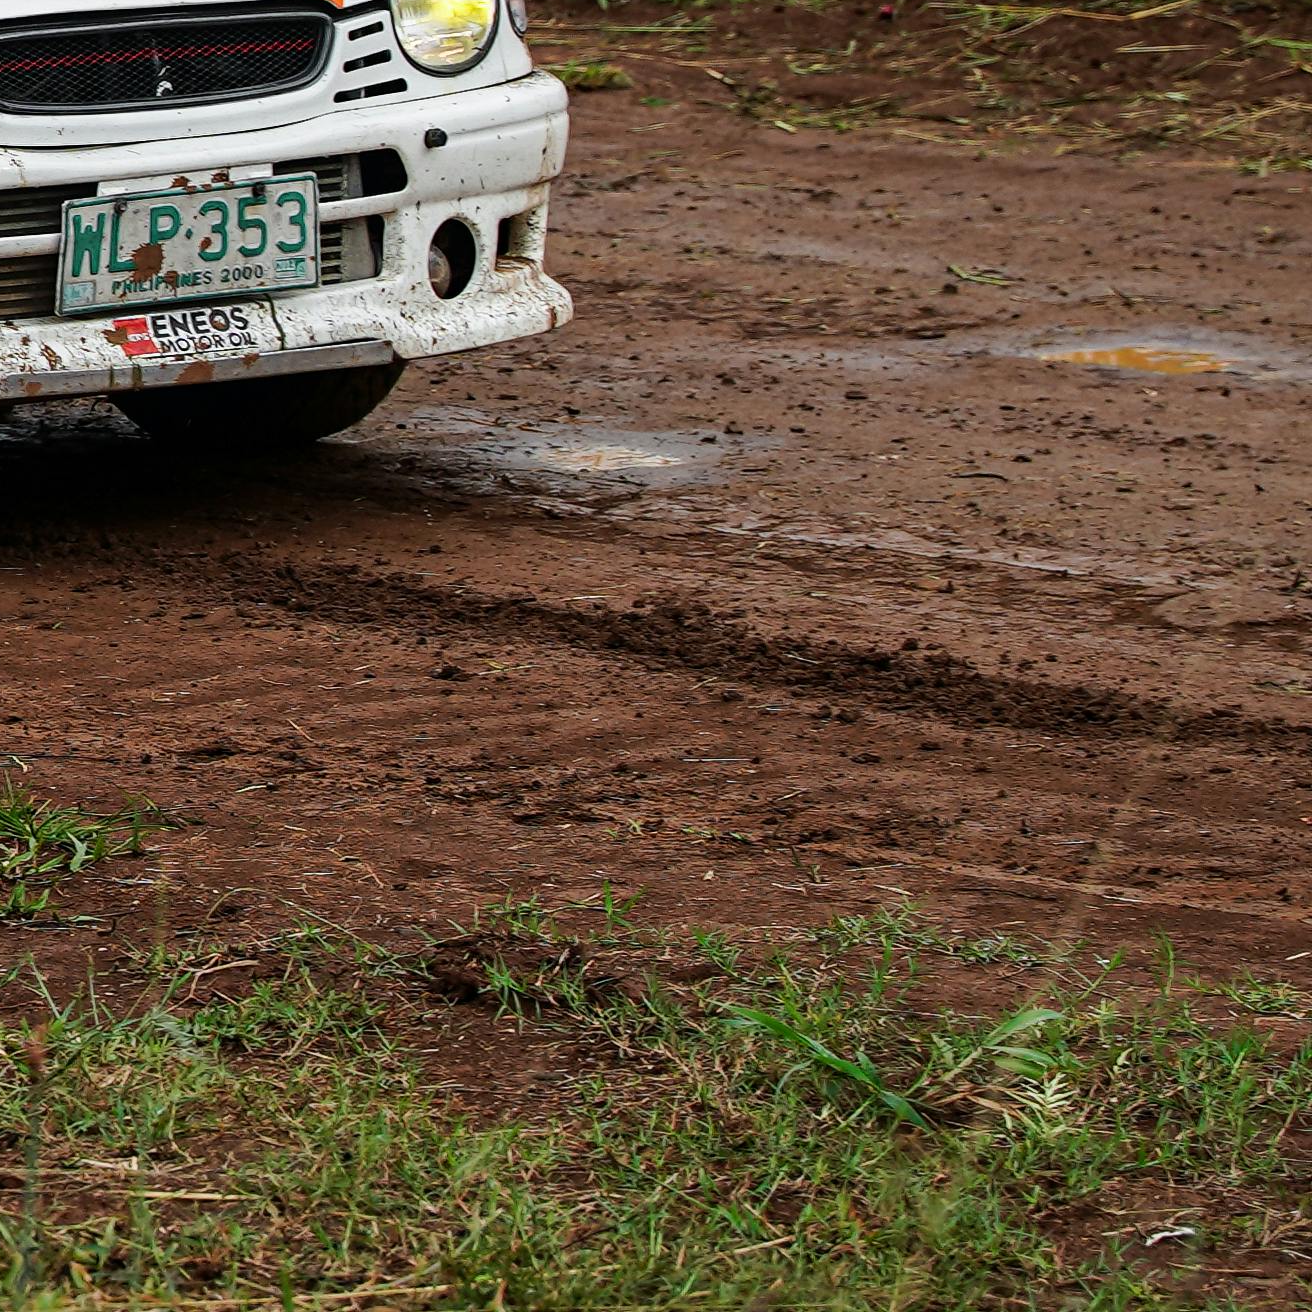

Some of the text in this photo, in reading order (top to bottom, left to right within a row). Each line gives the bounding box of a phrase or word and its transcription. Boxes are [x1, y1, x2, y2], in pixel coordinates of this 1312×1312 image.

[111, 270, 213, 295] PHILIPINES
[220, 263, 265, 284] 2000
[150, 306, 250, 339] ENEOS
[159, 332, 226, 354] MOTOR
[228, 330, 257, 348] OIL
